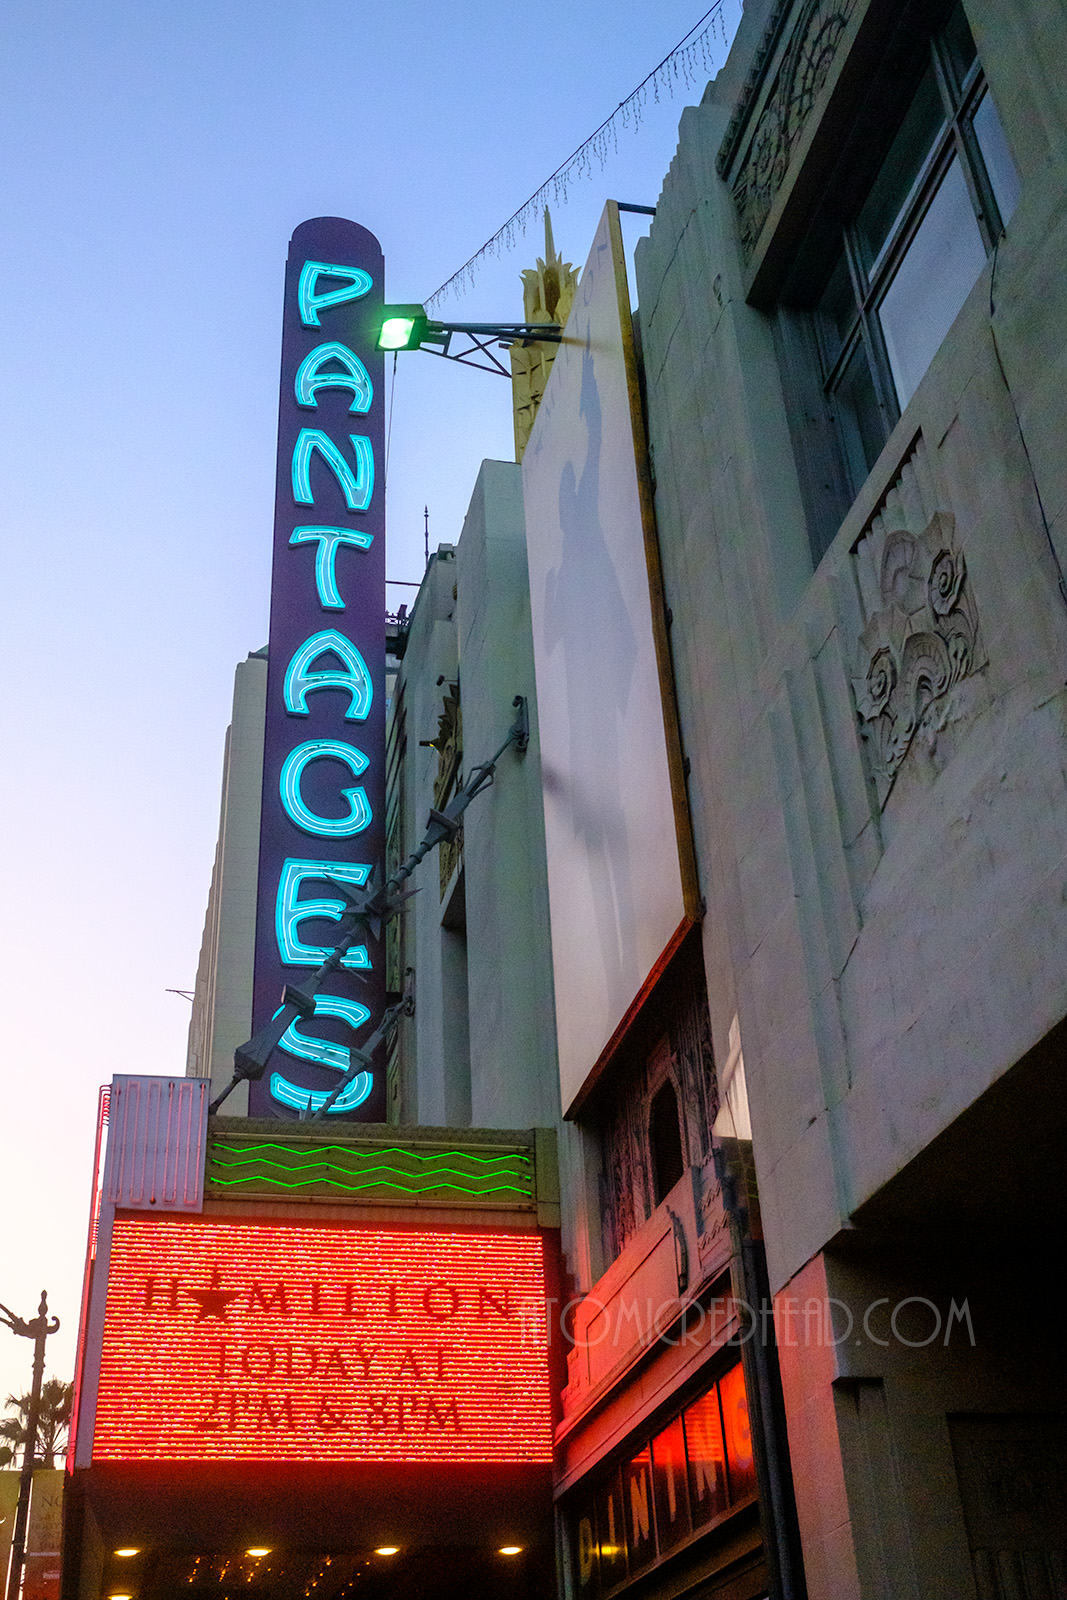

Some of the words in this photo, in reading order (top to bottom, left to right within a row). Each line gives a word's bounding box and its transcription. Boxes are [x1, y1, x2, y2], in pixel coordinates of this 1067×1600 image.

[269, 260, 374, 1114] PANTAGES
[211, 1340, 380, 1381] TODAY
[392, 1345, 453, 1384] AT
[196, 1391, 296, 1432] 2PM
[314, 1393, 351, 1433] &
[366, 1394, 464, 1434] 8PM
